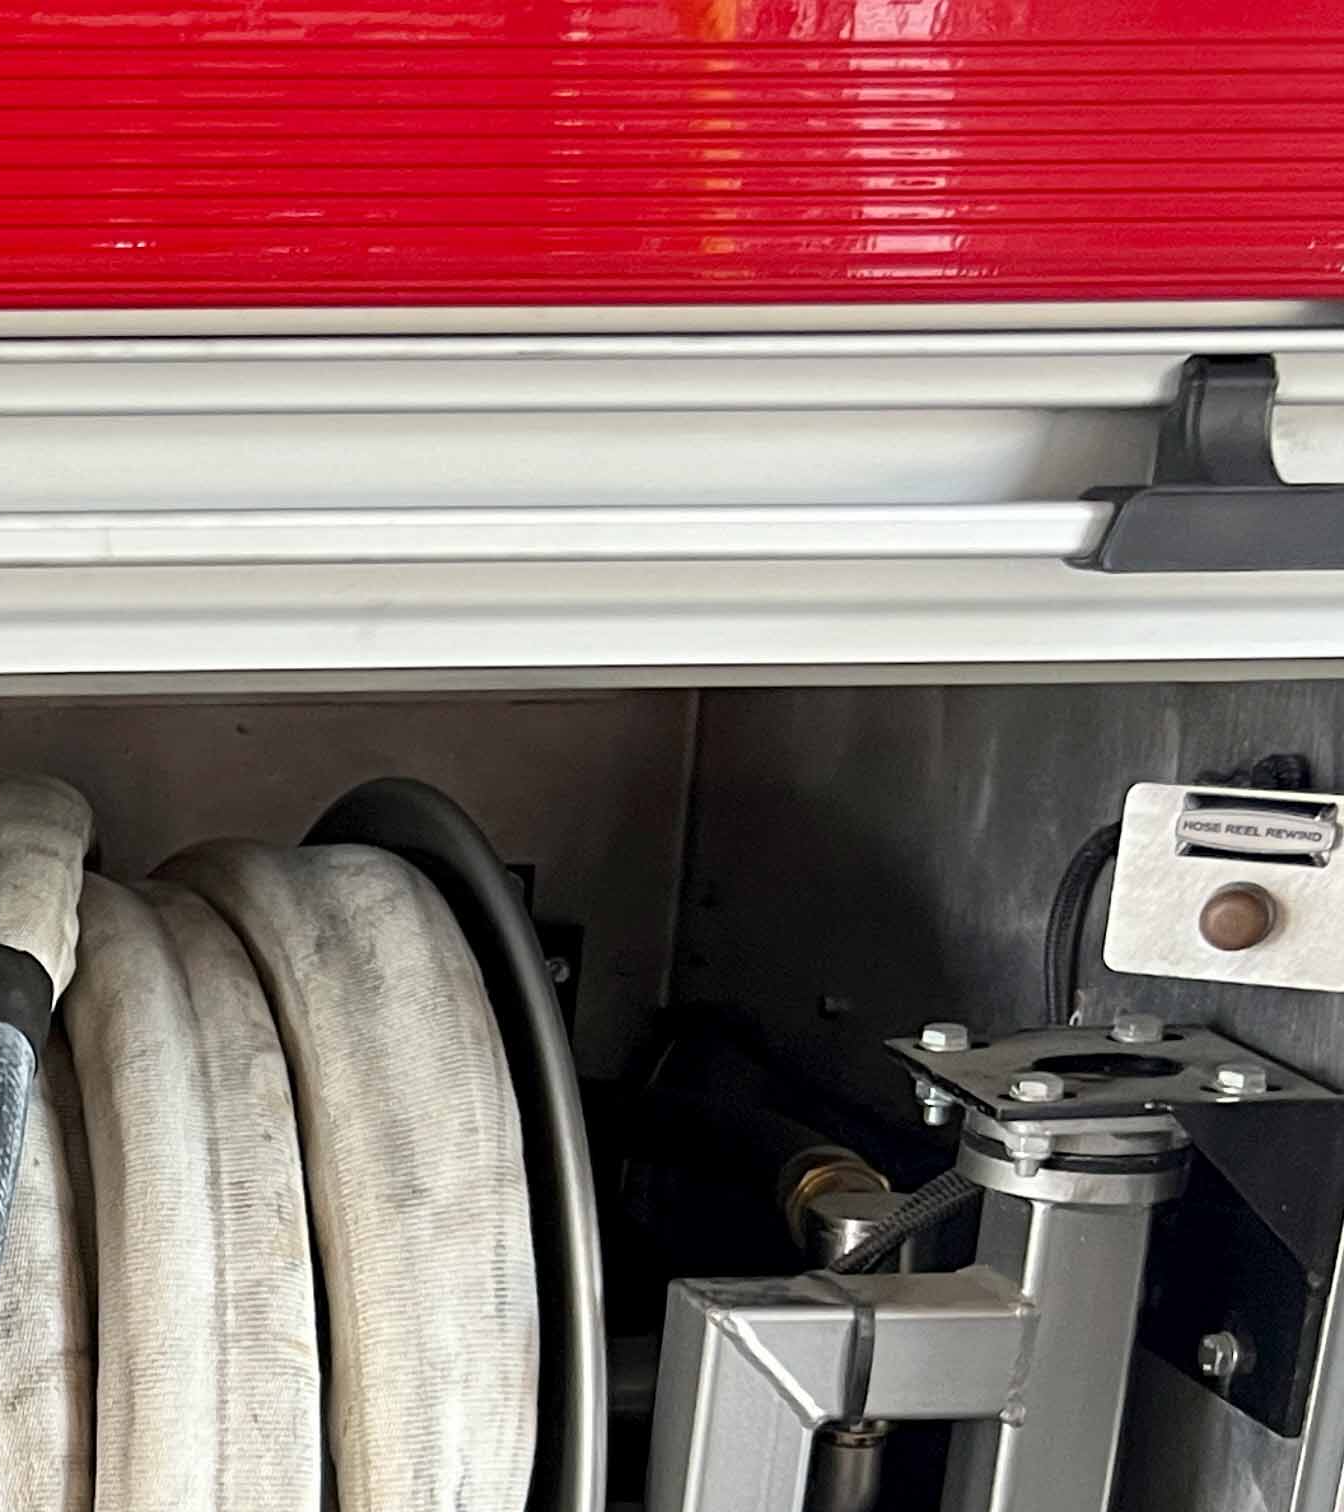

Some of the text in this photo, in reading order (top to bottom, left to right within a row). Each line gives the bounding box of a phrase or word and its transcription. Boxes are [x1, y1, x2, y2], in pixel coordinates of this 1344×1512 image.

[1183, 820, 1323, 842] HOSE REEL REWIND
